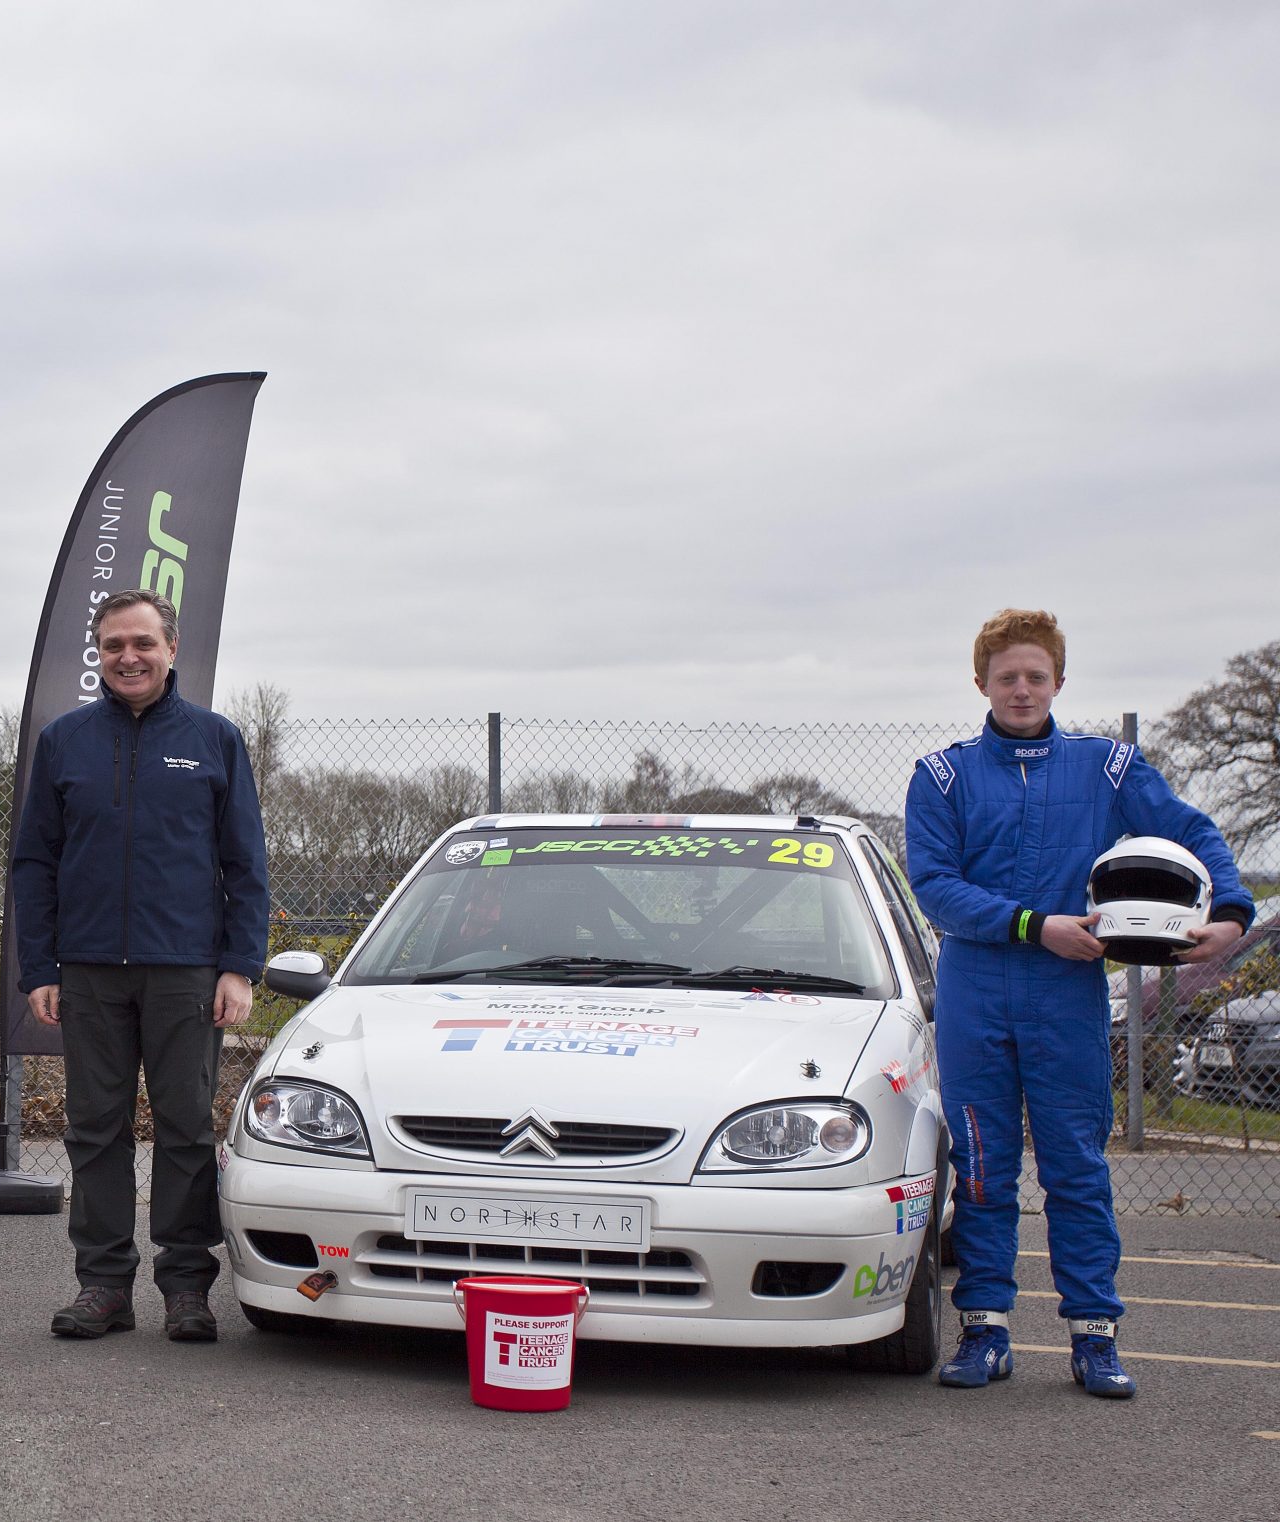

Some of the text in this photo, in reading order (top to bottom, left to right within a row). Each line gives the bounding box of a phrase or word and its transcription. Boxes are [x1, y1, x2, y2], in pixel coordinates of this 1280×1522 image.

[92, 480, 125, 580] JUNIOR
[1015, 747, 1049, 757] sparco
[1110, 743, 1129, 774] sparco
[927, 754, 949, 780] sparco
[515, 840, 641, 854] JSCC
[767, 838, 834, 868] 29
[577, 1004, 665, 1014] Group
[527, 1020, 699, 1037] TEENAGE
[514, 1030, 675, 1046] CANCER
[509, 1040, 637, 1056] TRUST
[904, 1179, 934, 1198] TEENAGE
[424, 1205, 632, 1232] NORTHSTAR
[909, 1212, 927, 1230] TRUST
[318, 1244, 350, 1258] TOW
[871, 1251, 915, 1297] ben
[494, 1318, 569, 1330] PLEASE SUPPORT
[967, 1313, 988, 1323] OMP
[1087, 1323, 1109, 1333] OMP
[520, 1333, 569, 1345] TEENAGE
[520, 1344, 564, 1356] CANCER
[520, 1356, 557, 1367] TRUST
